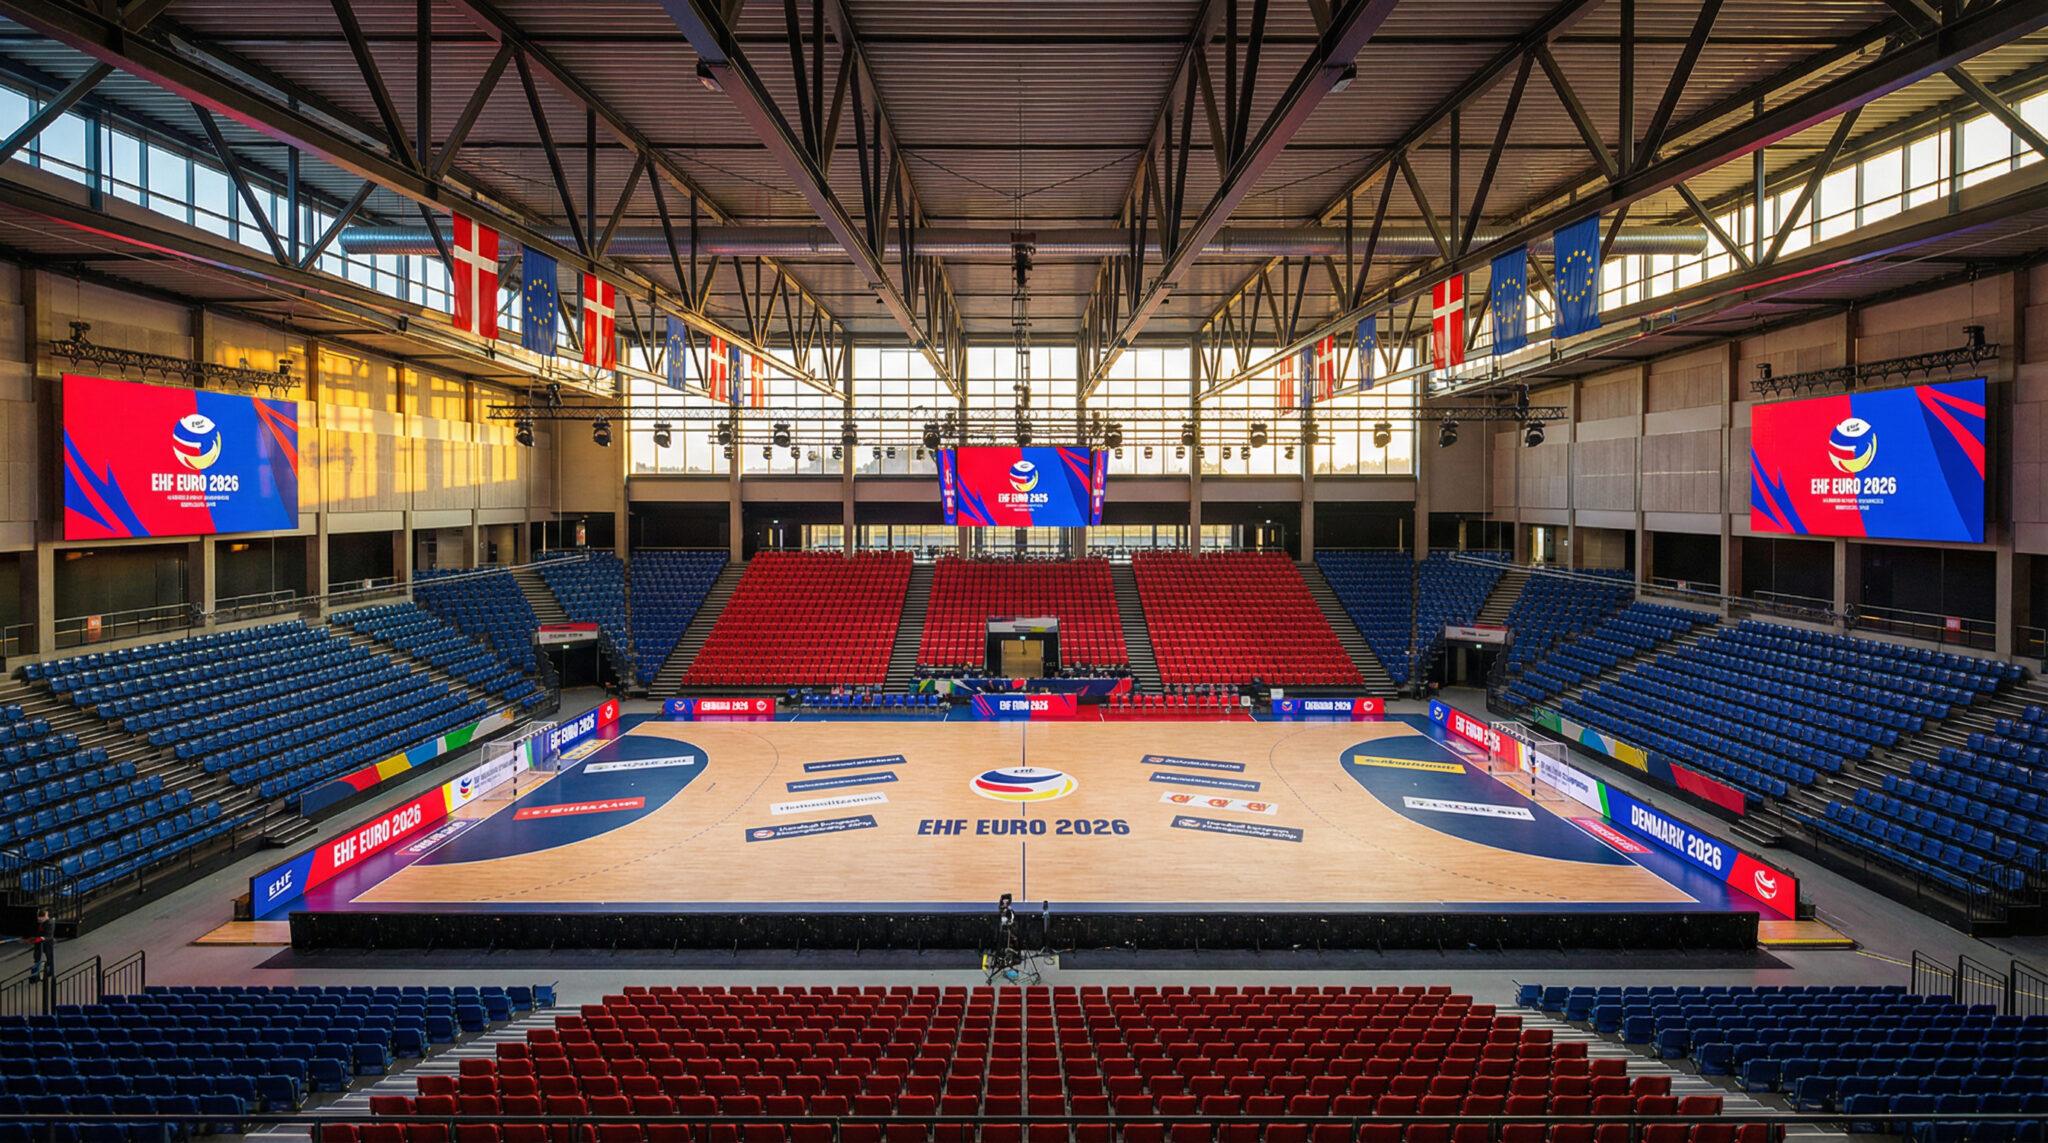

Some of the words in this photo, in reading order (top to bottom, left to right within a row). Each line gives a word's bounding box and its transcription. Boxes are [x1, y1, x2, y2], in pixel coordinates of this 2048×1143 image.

[151, 473, 174, 492] EHF
[176, 473, 207, 492] EURO
[209, 474, 240, 492] 2026
[1810, 477, 1830, 495] EHF
[1832, 477, 1861, 495] EURO
[1863, 476, 1897, 495] 2026
[333, 835, 357, 868] EHF
[359, 819, 390, 854] EURO
[392, 803, 422, 837] 2026
[917, 819, 968, 836] EHF
[975, 819, 1047, 836] EURO
[1055, 818, 1131, 836] 2026
[1631, 804, 1685, 852] DENMARK
[1687, 834, 1722, 871] 2026
[268, 869, 292, 897] EHF
